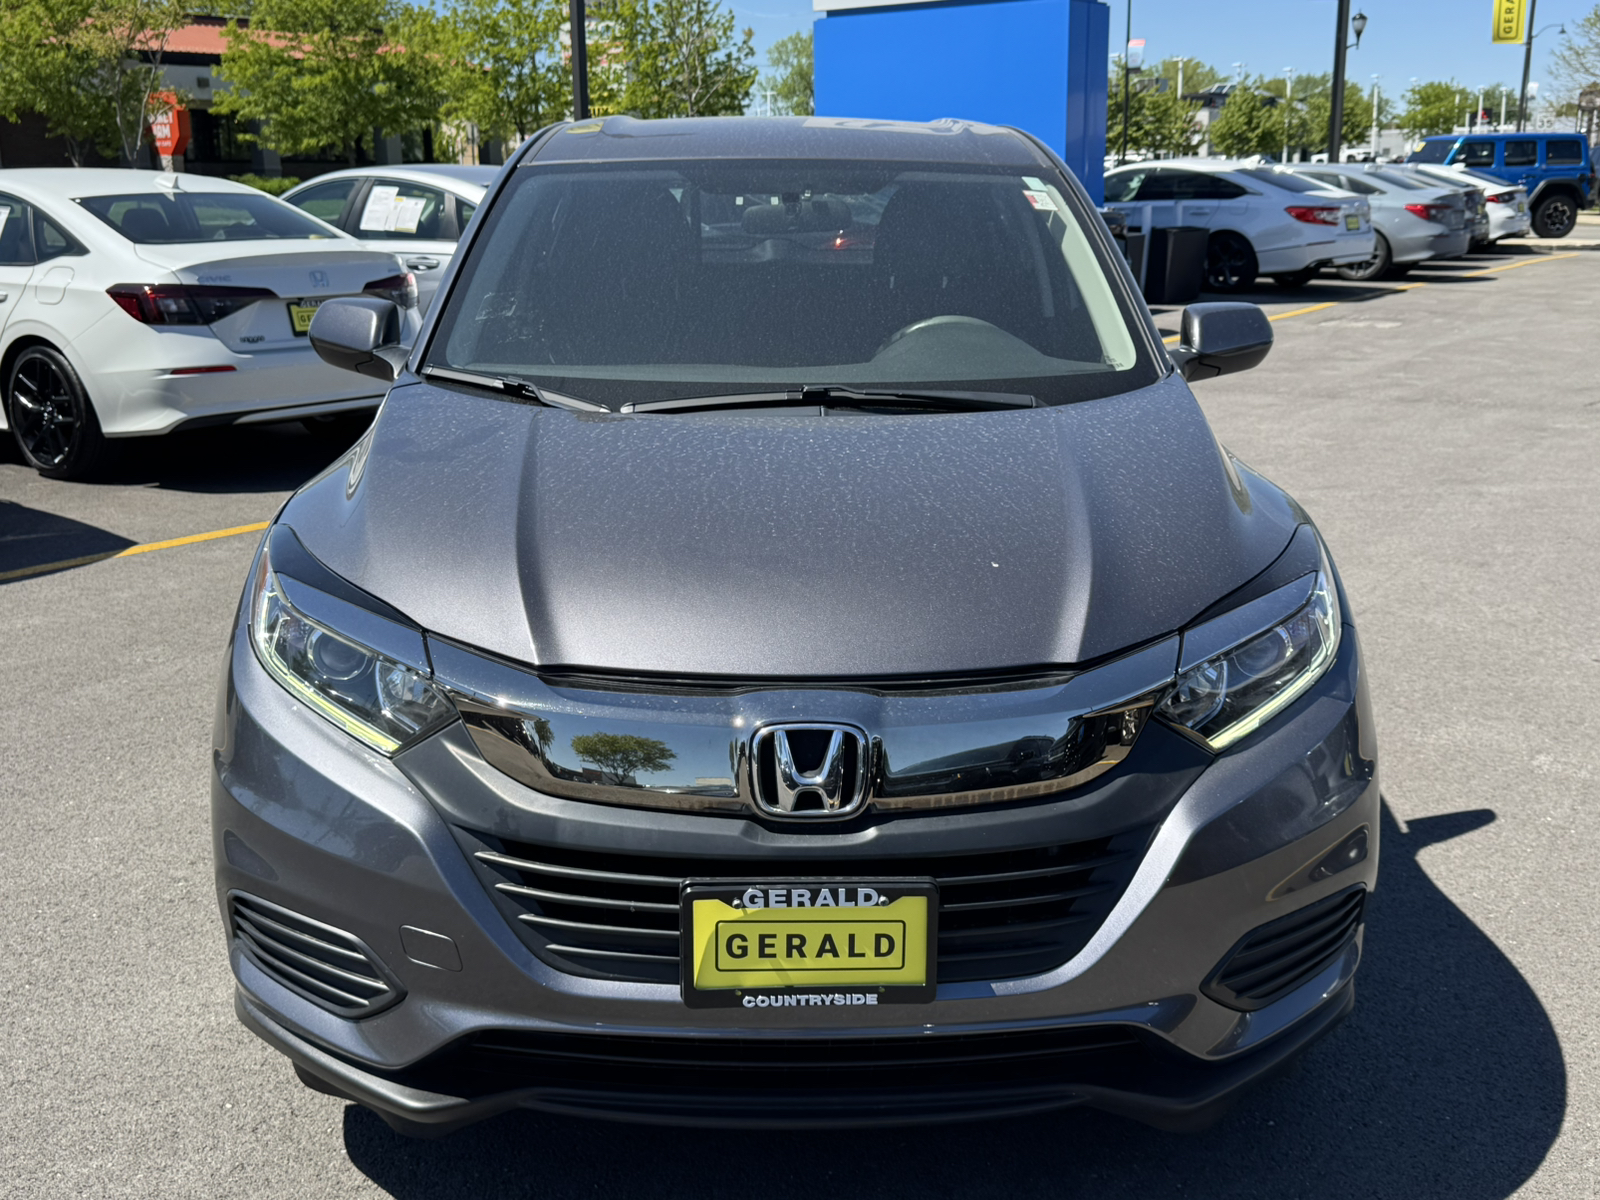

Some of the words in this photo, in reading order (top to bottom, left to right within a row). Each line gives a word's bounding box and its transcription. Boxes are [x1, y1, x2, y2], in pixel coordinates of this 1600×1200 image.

[197, 275, 232, 283] CIVIC
[742, 887, 879, 908] GERALD
[725, 933, 896, 959] GERALD
[742, 993, 879, 1008] COUNTRYSIDE
